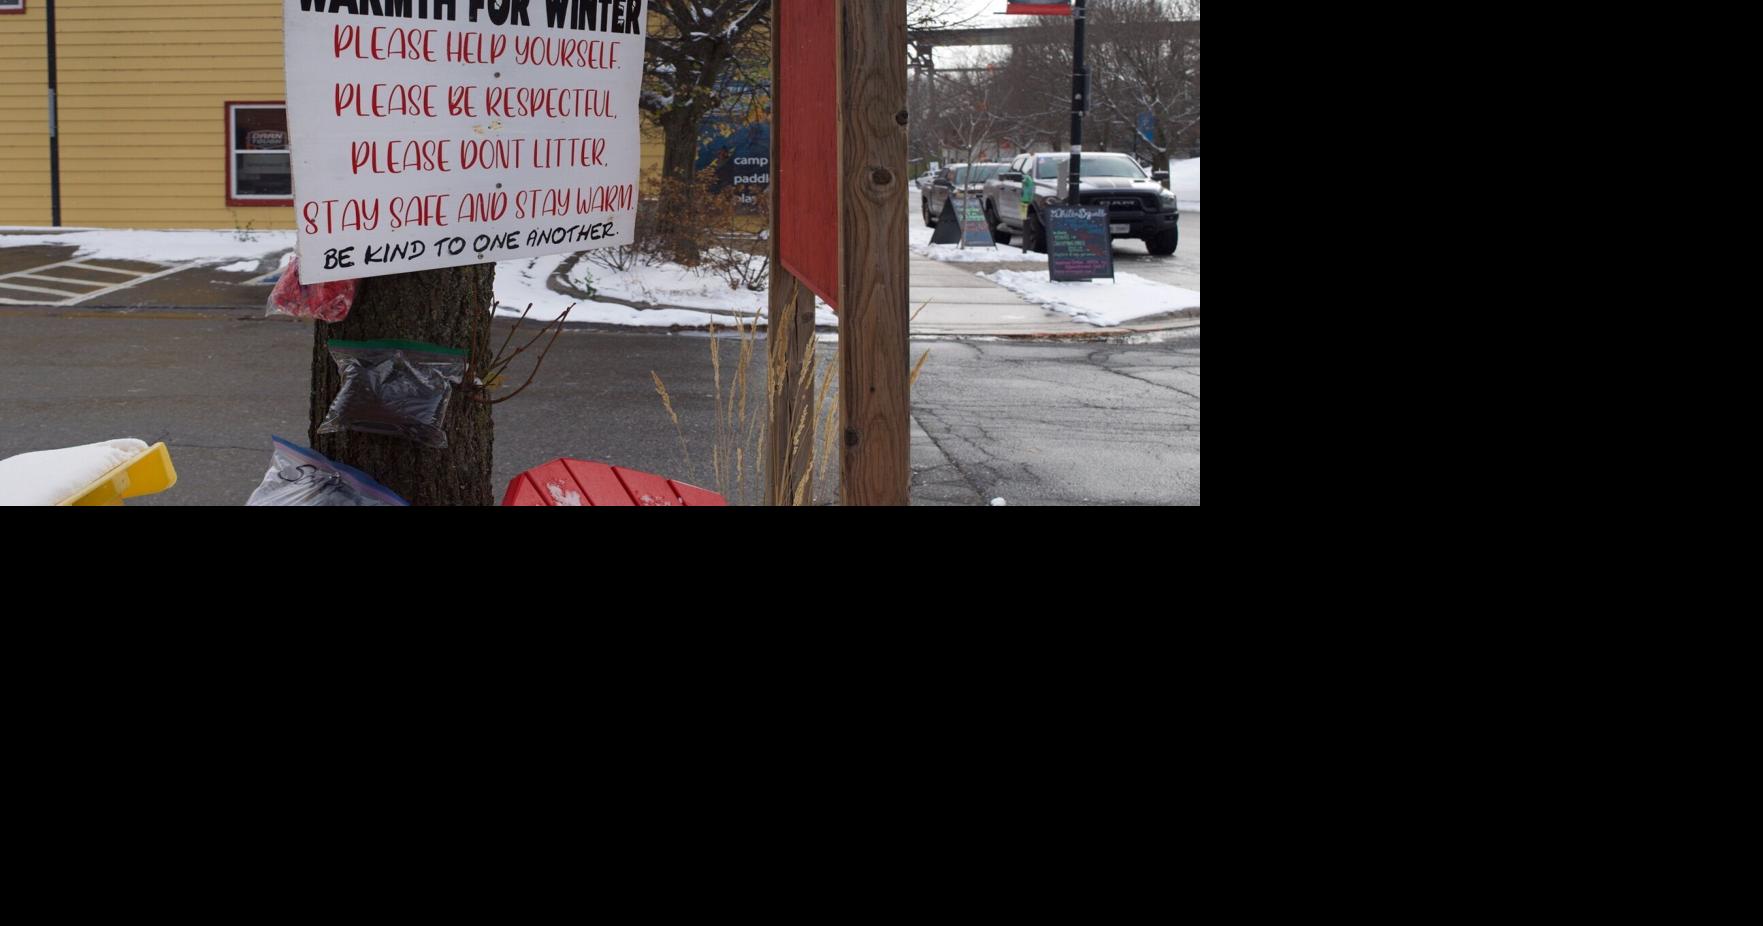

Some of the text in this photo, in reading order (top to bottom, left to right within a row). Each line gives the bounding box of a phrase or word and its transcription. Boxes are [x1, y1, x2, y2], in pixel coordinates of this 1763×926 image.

[469, 0, 530, 26] FOR
[546, 0, 641, 35] WINTER
[333, 24, 621, 70] PLEASE HELP YOURSELF.
[334, 82, 438, 118] PLEASE
[448, 84, 478, 118] BE
[351, 140, 450, 175] PLEASE
[460, 138, 525, 171] DONT
[734, 157, 768, 167] camp
[734, 173, 769, 185] paddl
[303, 183, 635, 235] STAY SAFE AND STAY WARM.
[323, 221, 620, 270] BE KIND TO ONE ANOTHER.
